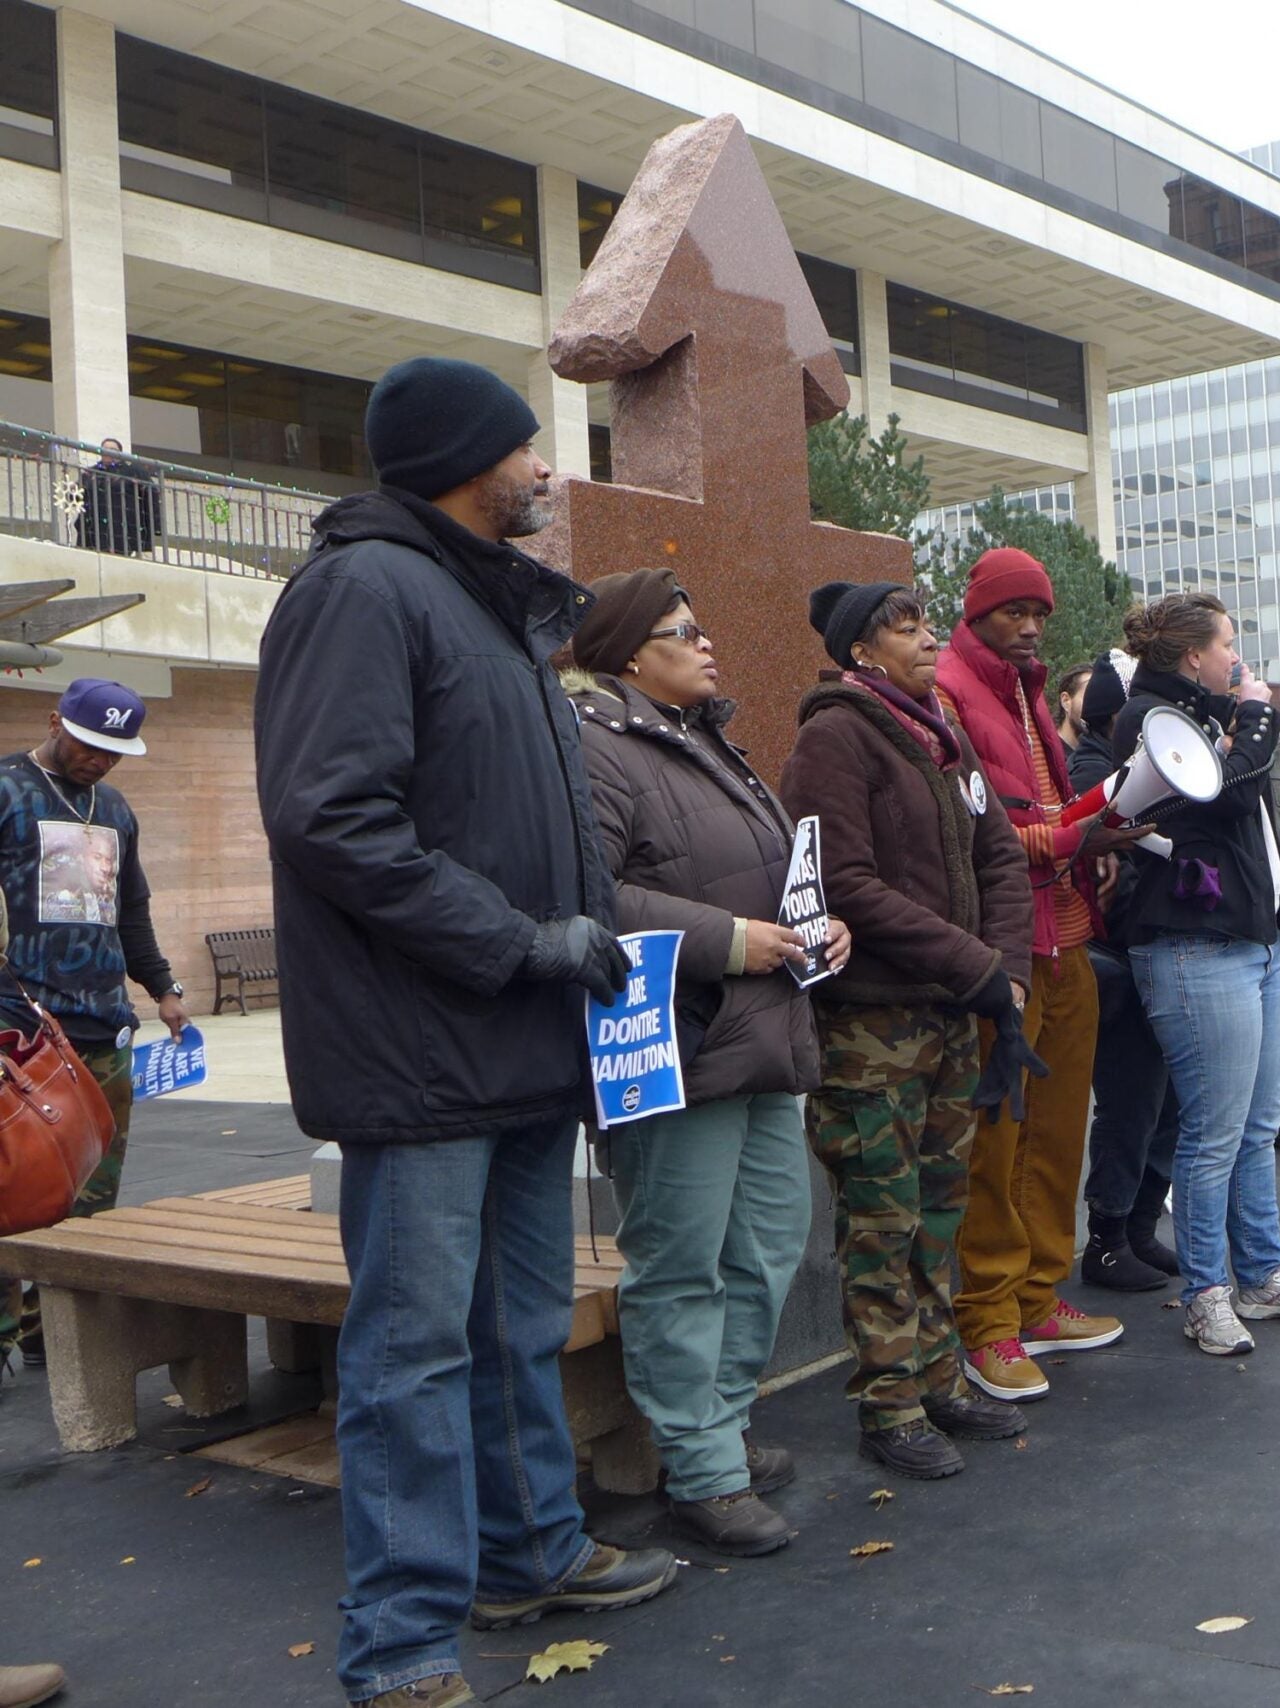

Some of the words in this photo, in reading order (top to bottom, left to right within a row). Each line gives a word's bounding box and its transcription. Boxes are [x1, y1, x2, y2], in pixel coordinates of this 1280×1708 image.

[104, 707, 133, 728] M
[783, 887, 820, 923] YOUR
[626, 975, 648, 1008] ARE
[598, 1007, 661, 1046] DONTRE
[145, 1041, 164, 1096] HAMILT
[160, 1042, 177, 1092] DONTR
[175, 1052, 189, 1080] ARE
[191, 1046, 204, 1072] WE
